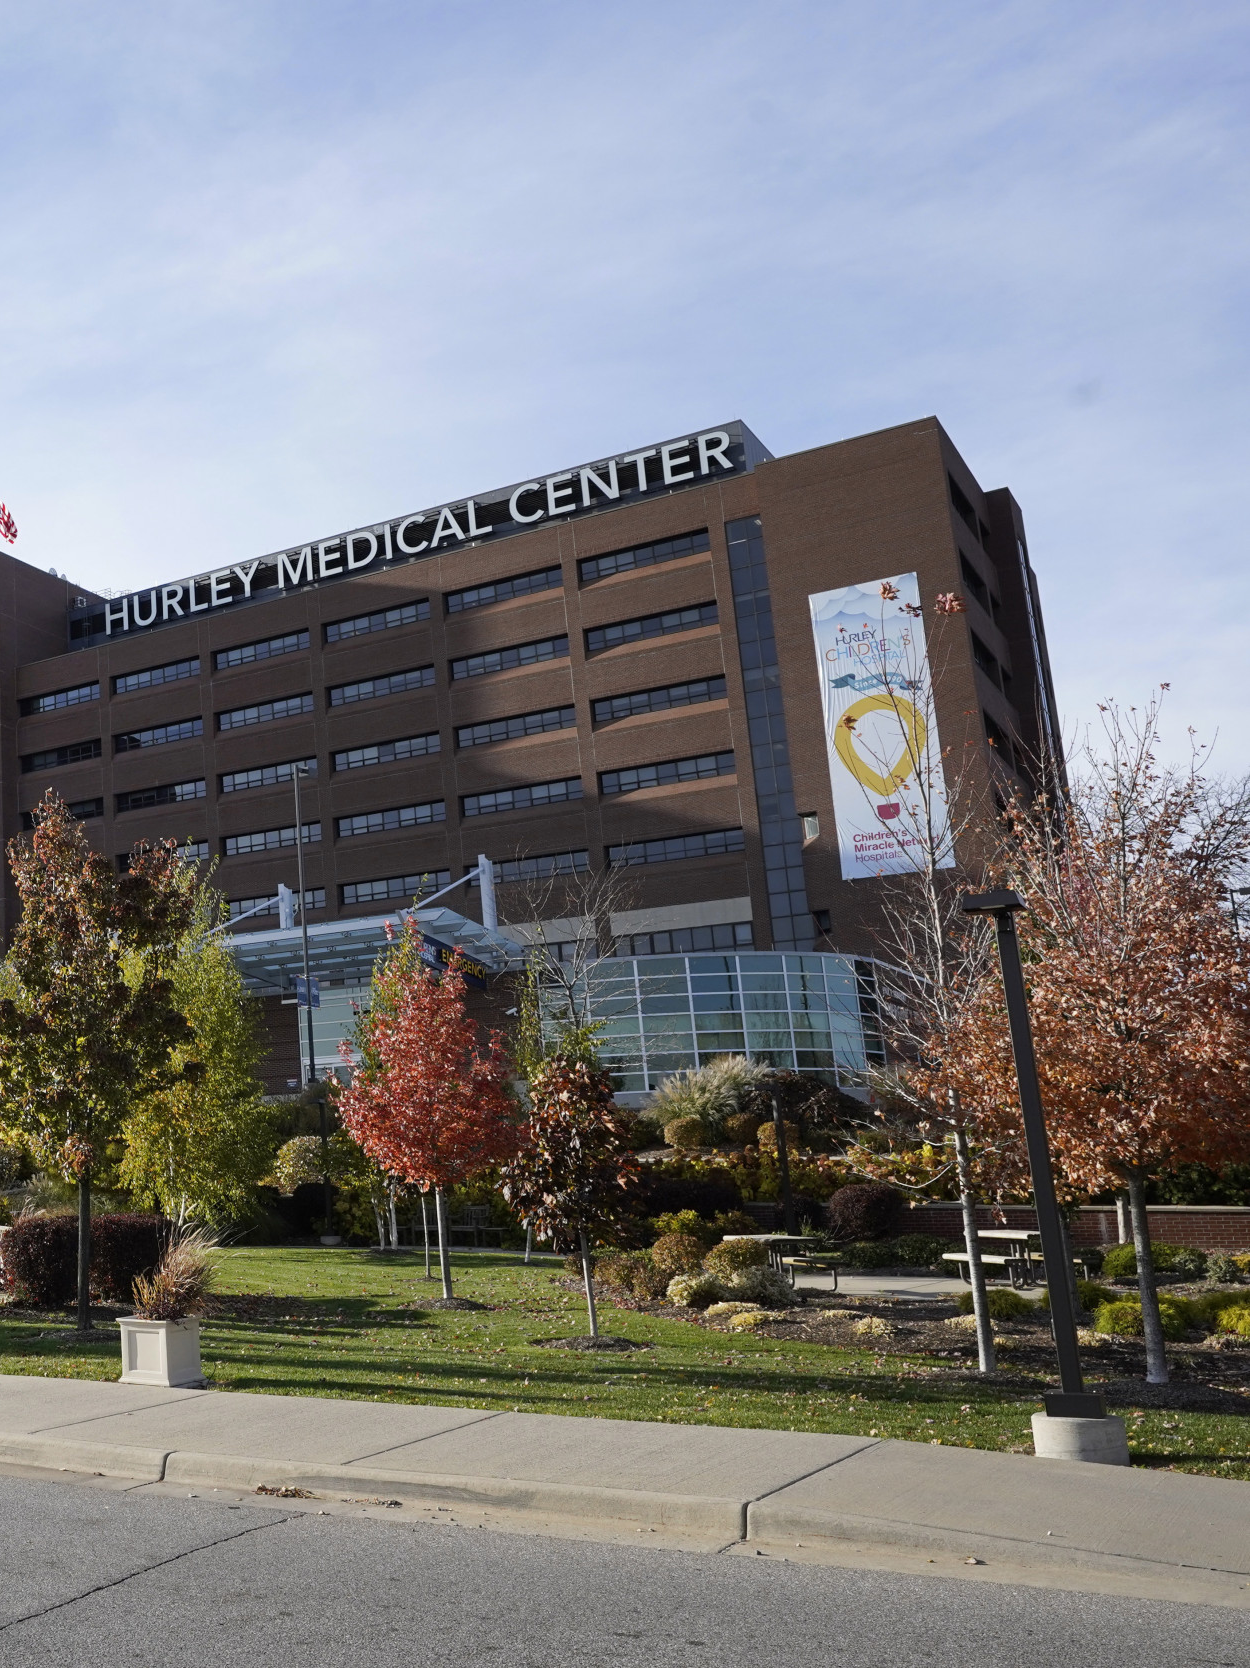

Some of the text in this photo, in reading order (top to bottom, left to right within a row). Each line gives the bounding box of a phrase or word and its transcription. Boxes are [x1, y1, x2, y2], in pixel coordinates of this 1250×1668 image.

[104, 429, 735, 636] HURLEY MEDICAL CENTER
[835, 629, 876, 645] HURLEY
[854, 675, 902, 689] Since 990
[853, 829, 908, 843] Children's
[854, 834, 940, 853] Miracle Netrk
[855, 850, 903, 862] Hospitals
[441, 949, 486, 979] EMRGENCY
